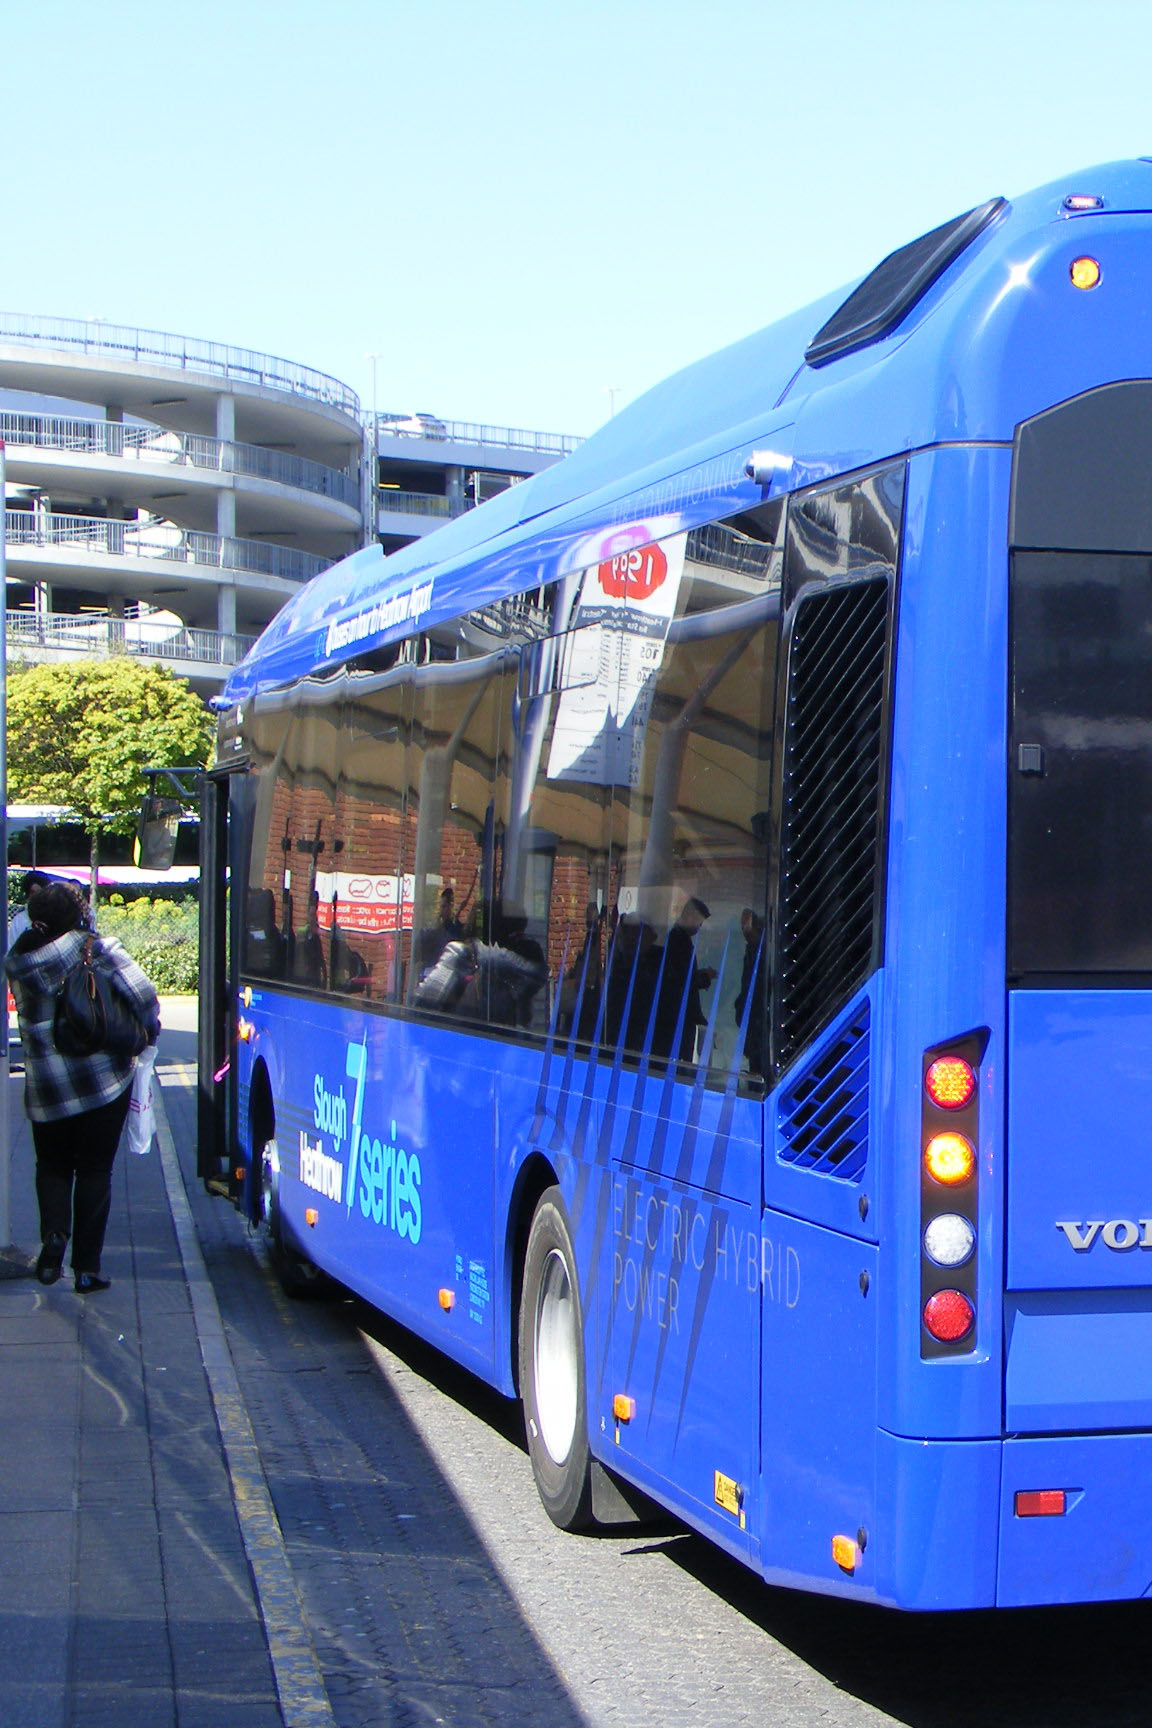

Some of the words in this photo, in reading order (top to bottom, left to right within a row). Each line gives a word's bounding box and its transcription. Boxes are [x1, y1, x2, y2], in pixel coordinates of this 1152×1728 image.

[408, 577, 434, 625] Airport
[313, 1073, 347, 1153] Slough
[299, 1130, 344, 1204] Heathrow
[359, 1119, 422, 1245] series
[613, 1183, 706, 1271] ELECTRIC
[714, 1219, 801, 1309] HYBRID
[612, 1251, 680, 1336] POWER
